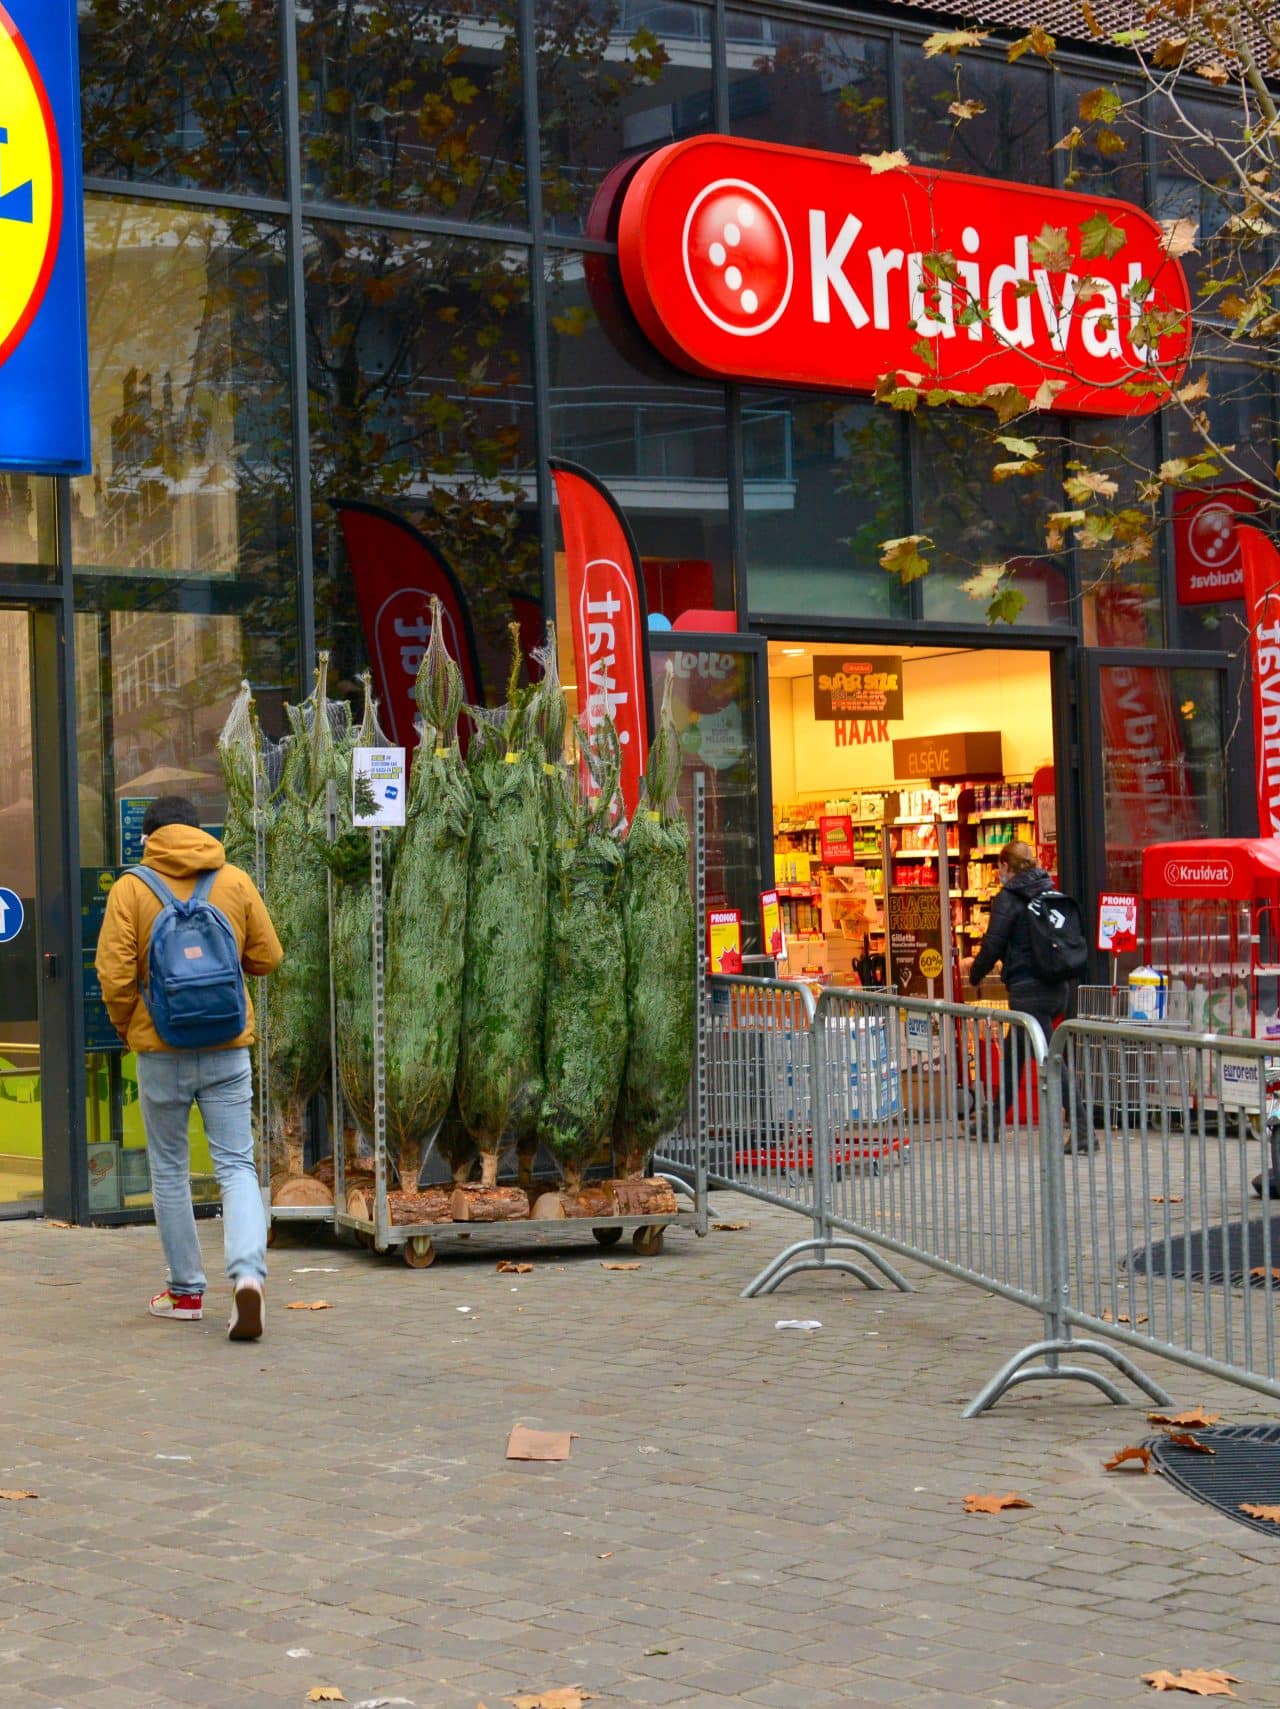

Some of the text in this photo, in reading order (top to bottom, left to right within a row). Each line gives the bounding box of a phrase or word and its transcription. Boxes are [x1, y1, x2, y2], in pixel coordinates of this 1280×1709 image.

[808, 208, 1159, 364] Kruidvat
[834, 719, 890, 747] HAAR
[1179, 866, 1229, 881] Kruidvat
[889, 895, 939, 913] BLACK
[1102, 896, 1135, 906] PROMO!
[710, 912, 737, 923] PROMO!
[890, 913, 940, 929] FRIDAY
[920, 955, 942, 967] 60%
[1223, 1063, 1258, 1080] eurorent
